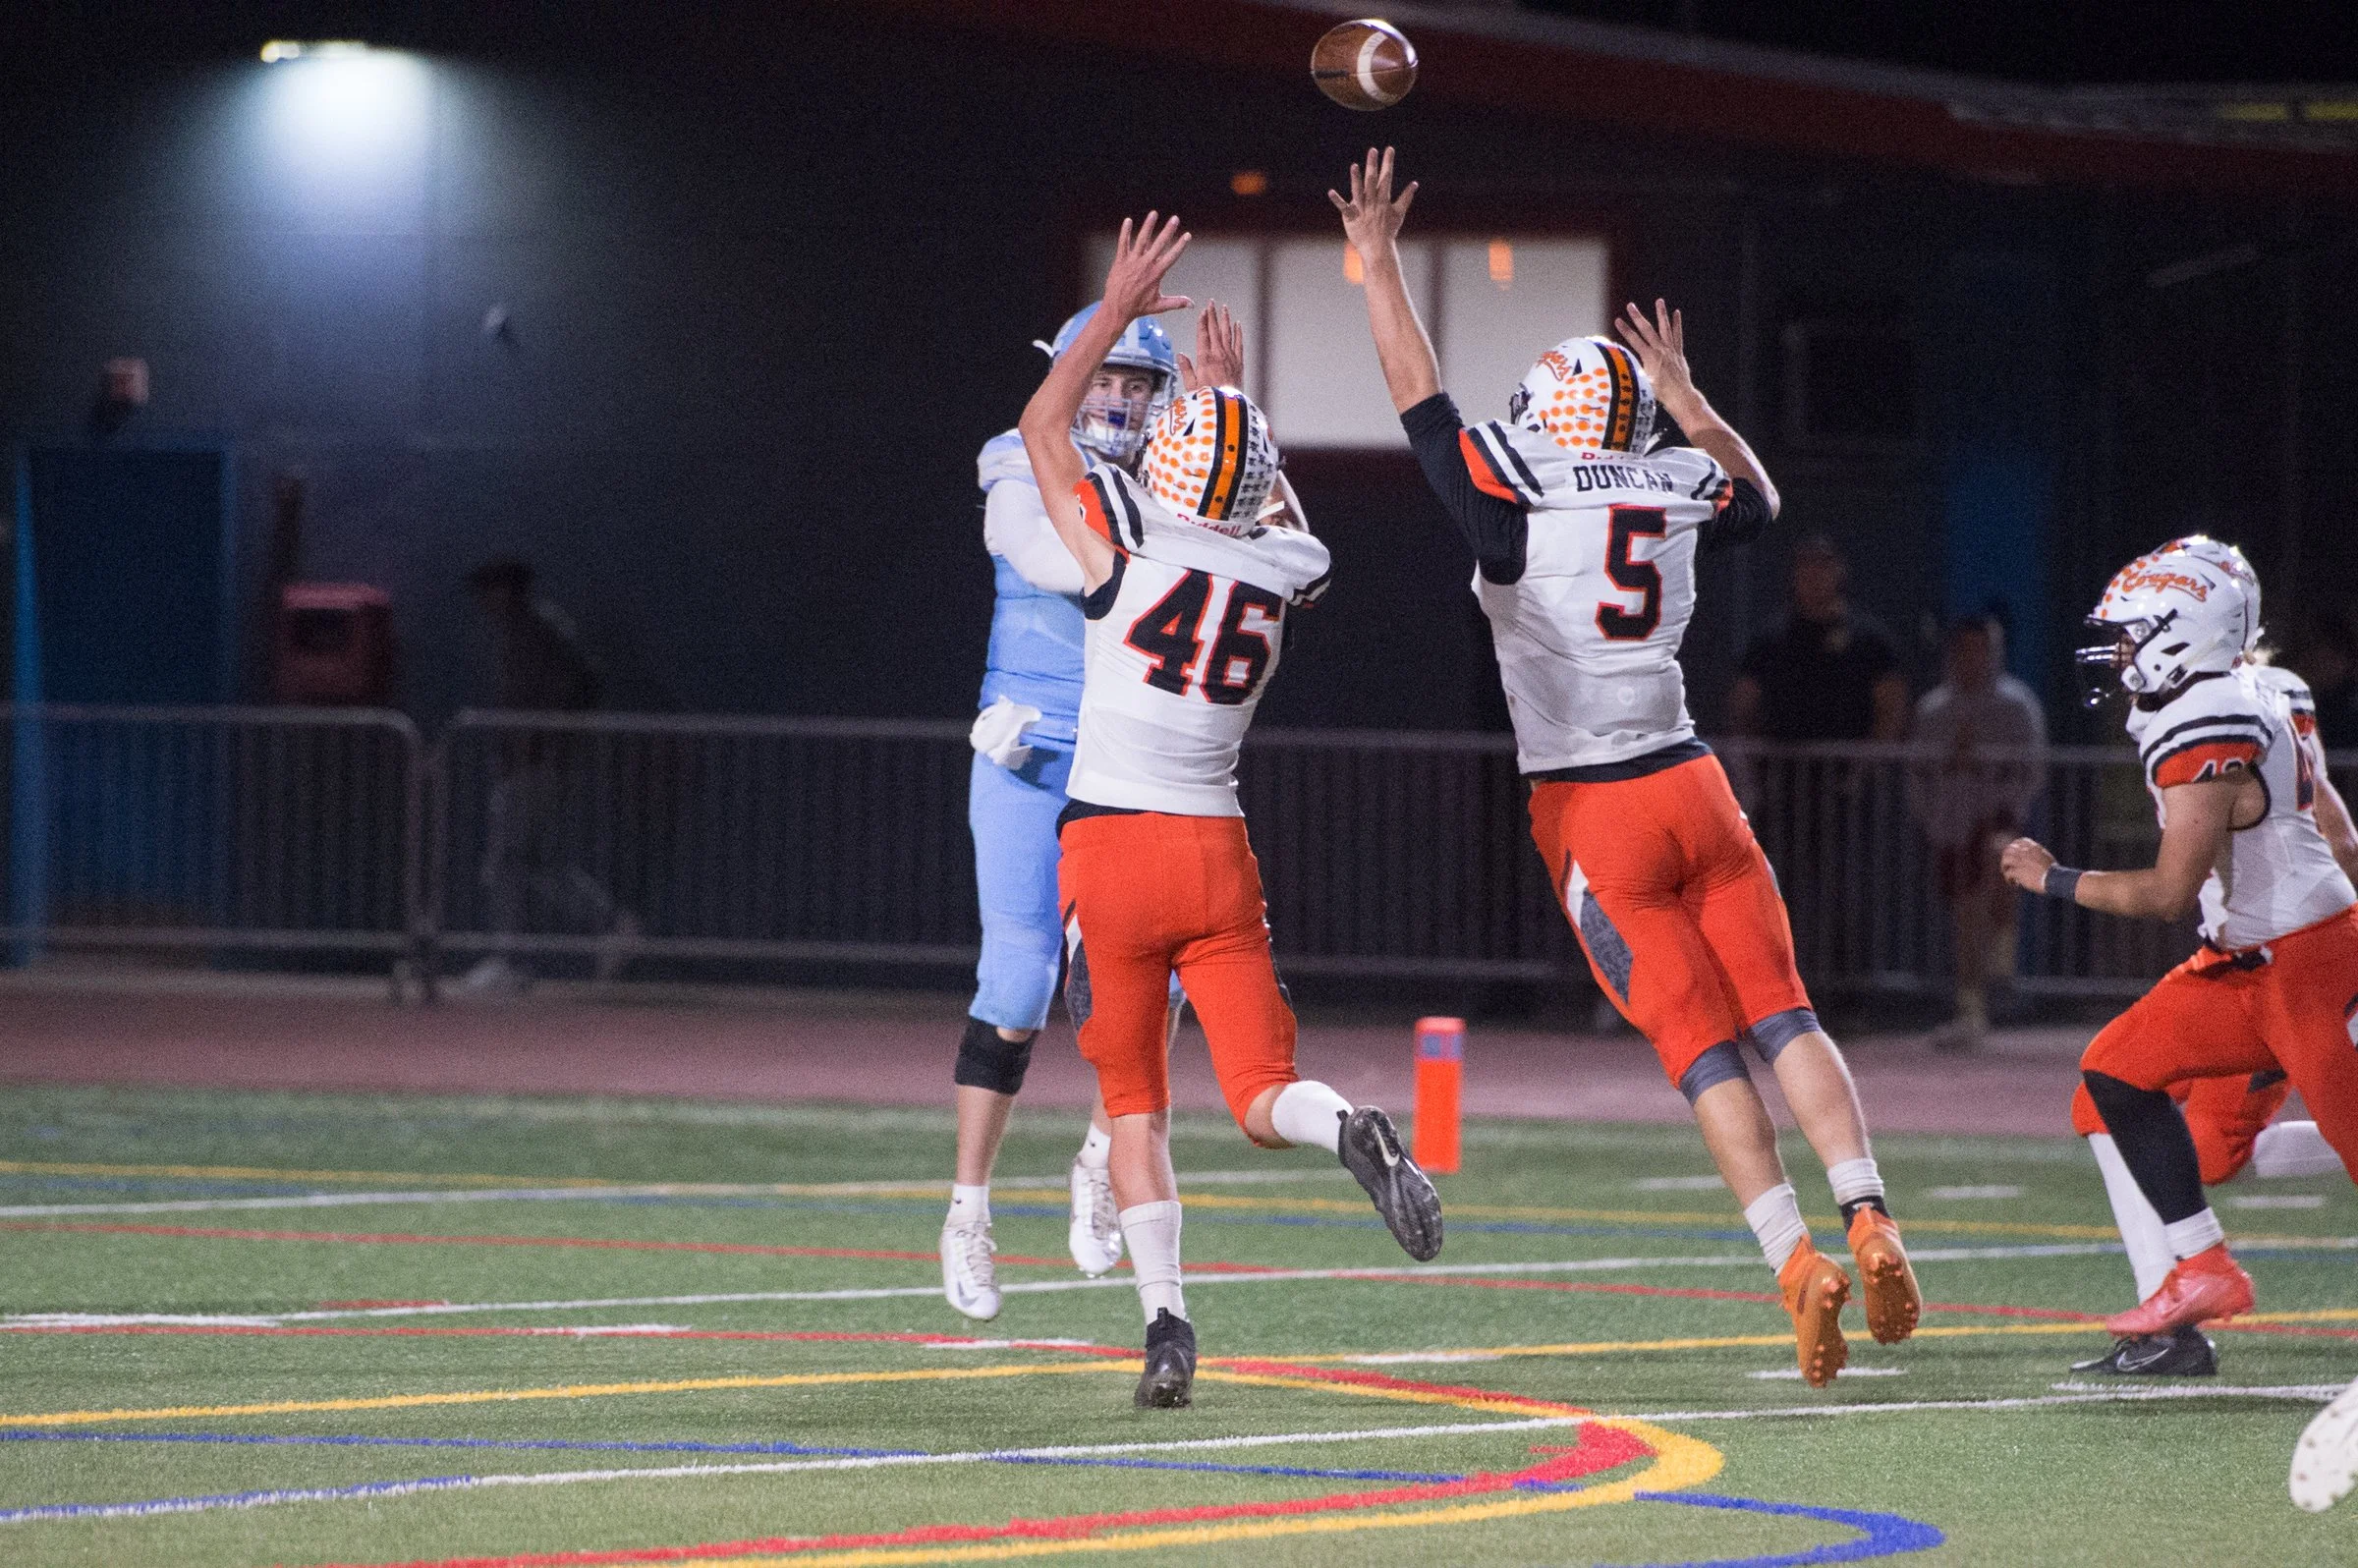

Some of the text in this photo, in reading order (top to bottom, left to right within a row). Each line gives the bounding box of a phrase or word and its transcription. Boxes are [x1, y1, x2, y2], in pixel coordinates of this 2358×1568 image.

[1572, 465, 1673, 493] DUNCAN
[1177, 513, 1241, 535] ddell
[1596, 504, 1667, 642] 5
[2122, 573, 2208, 603] Cougars
[1123, 569, 1279, 705] 46
